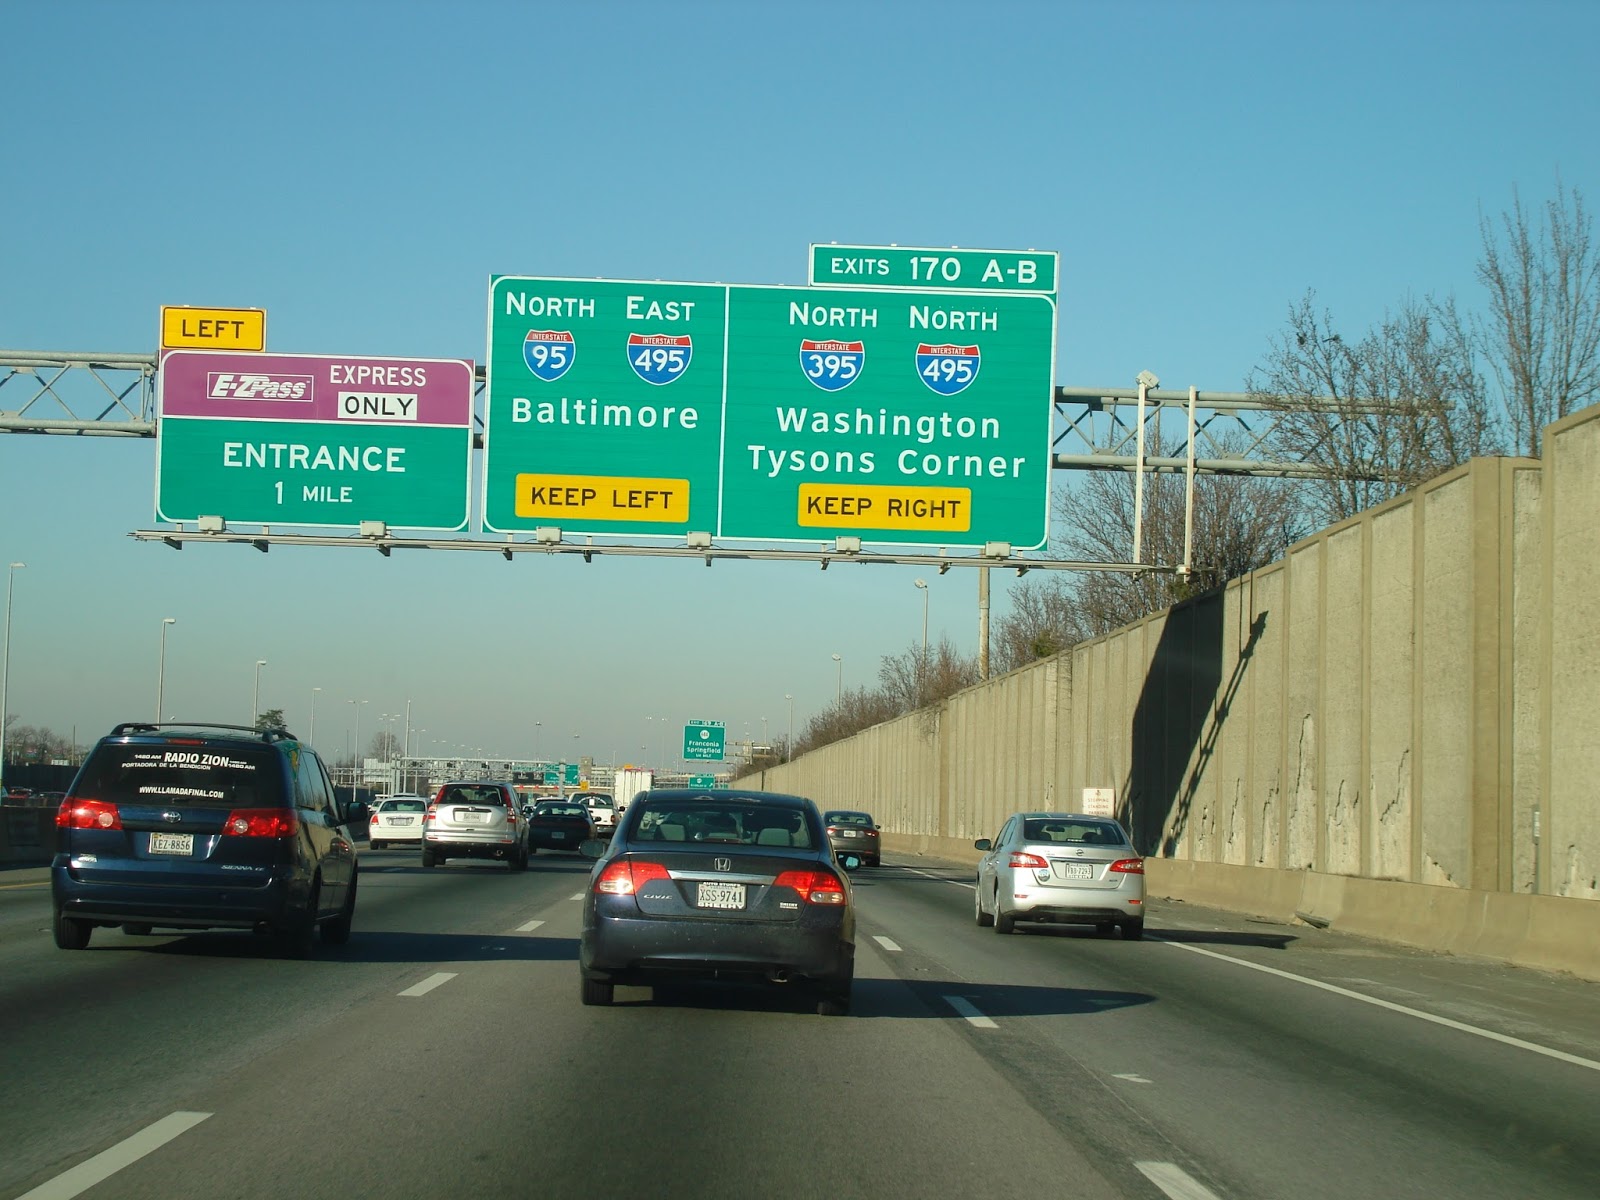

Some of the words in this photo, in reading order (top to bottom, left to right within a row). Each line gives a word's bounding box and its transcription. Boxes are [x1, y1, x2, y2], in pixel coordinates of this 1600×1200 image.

[831, 258, 890, 275] EXITS
[910, 257, 961, 281] 170
[981, 259, 1037, 284] A-B
[182, 319, 244, 339] LEFT
[532, 333, 568, 341] INTERSTATE
[642, 337, 678, 345] INTERSTATE
[814, 343, 850, 351] INTERSTATE
[930, 347, 966, 355] INTERSTATE
[532, 345, 566, 369] 95
[635, 349, 684, 373] 495
[808, 354, 857, 379] 395
[330, 365, 426, 387] EXPRESS
[923, 358, 972, 383] 495
[210, 375, 307, 399] E-ZPass
[344, 396, 414, 416] ONLY
[512, 397, 698, 429] Baltimore
[776, 407, 1000, 443] Washington
[223, 442, 406, 473] ENTRANCE
[747, 445, 875, 478] Tysons
[898, 450, 1026, 478] Corner
[275, 481, 283, 504] 1
[303, 486, 353, 503] MILE
[531, 487, 597, 506] KEEP
[612, 489, 673, 509] LEFT
[807, 497, 872, 516] KEEP
[888, 499, 961, 519] RIGHT
[164, 752, 199, 763] RADIO
[201, 754, 229, 767] ZION
[139, 786, 224, 798] WWW.LLAMADAFINAL.COM
